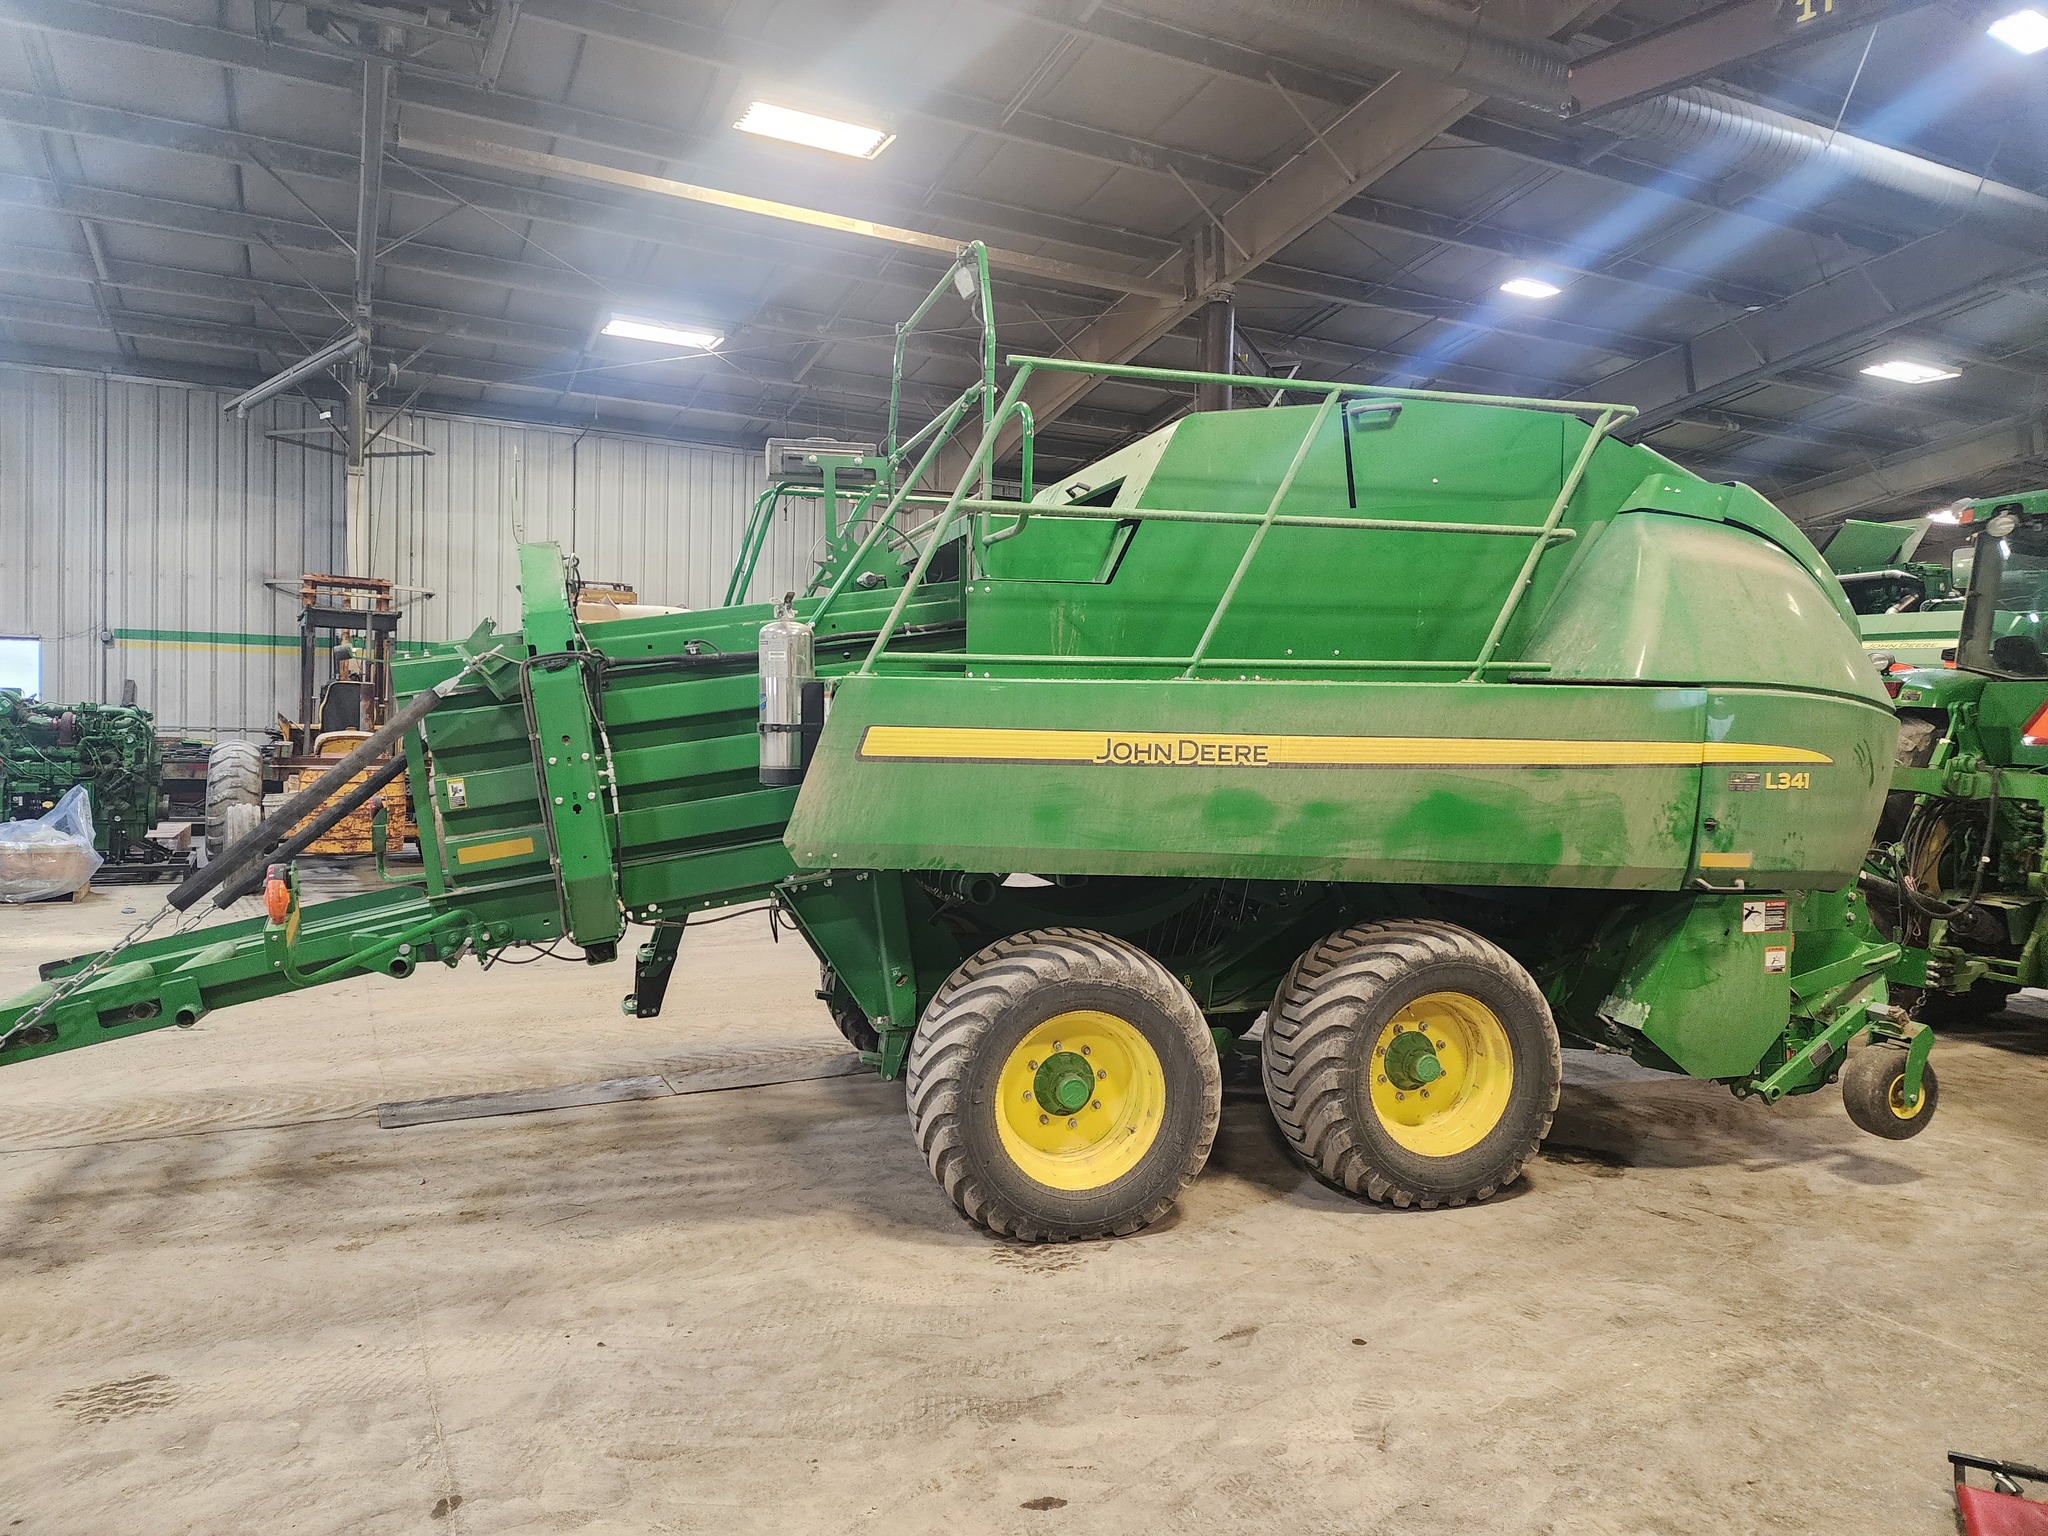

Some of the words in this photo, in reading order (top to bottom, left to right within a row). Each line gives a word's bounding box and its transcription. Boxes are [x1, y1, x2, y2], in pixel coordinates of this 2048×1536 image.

[1096, 738, 1172, 761] JOHN
[1178, 739, 1269, 763] DEERE
[1765, 772, 1811, 790] L341
